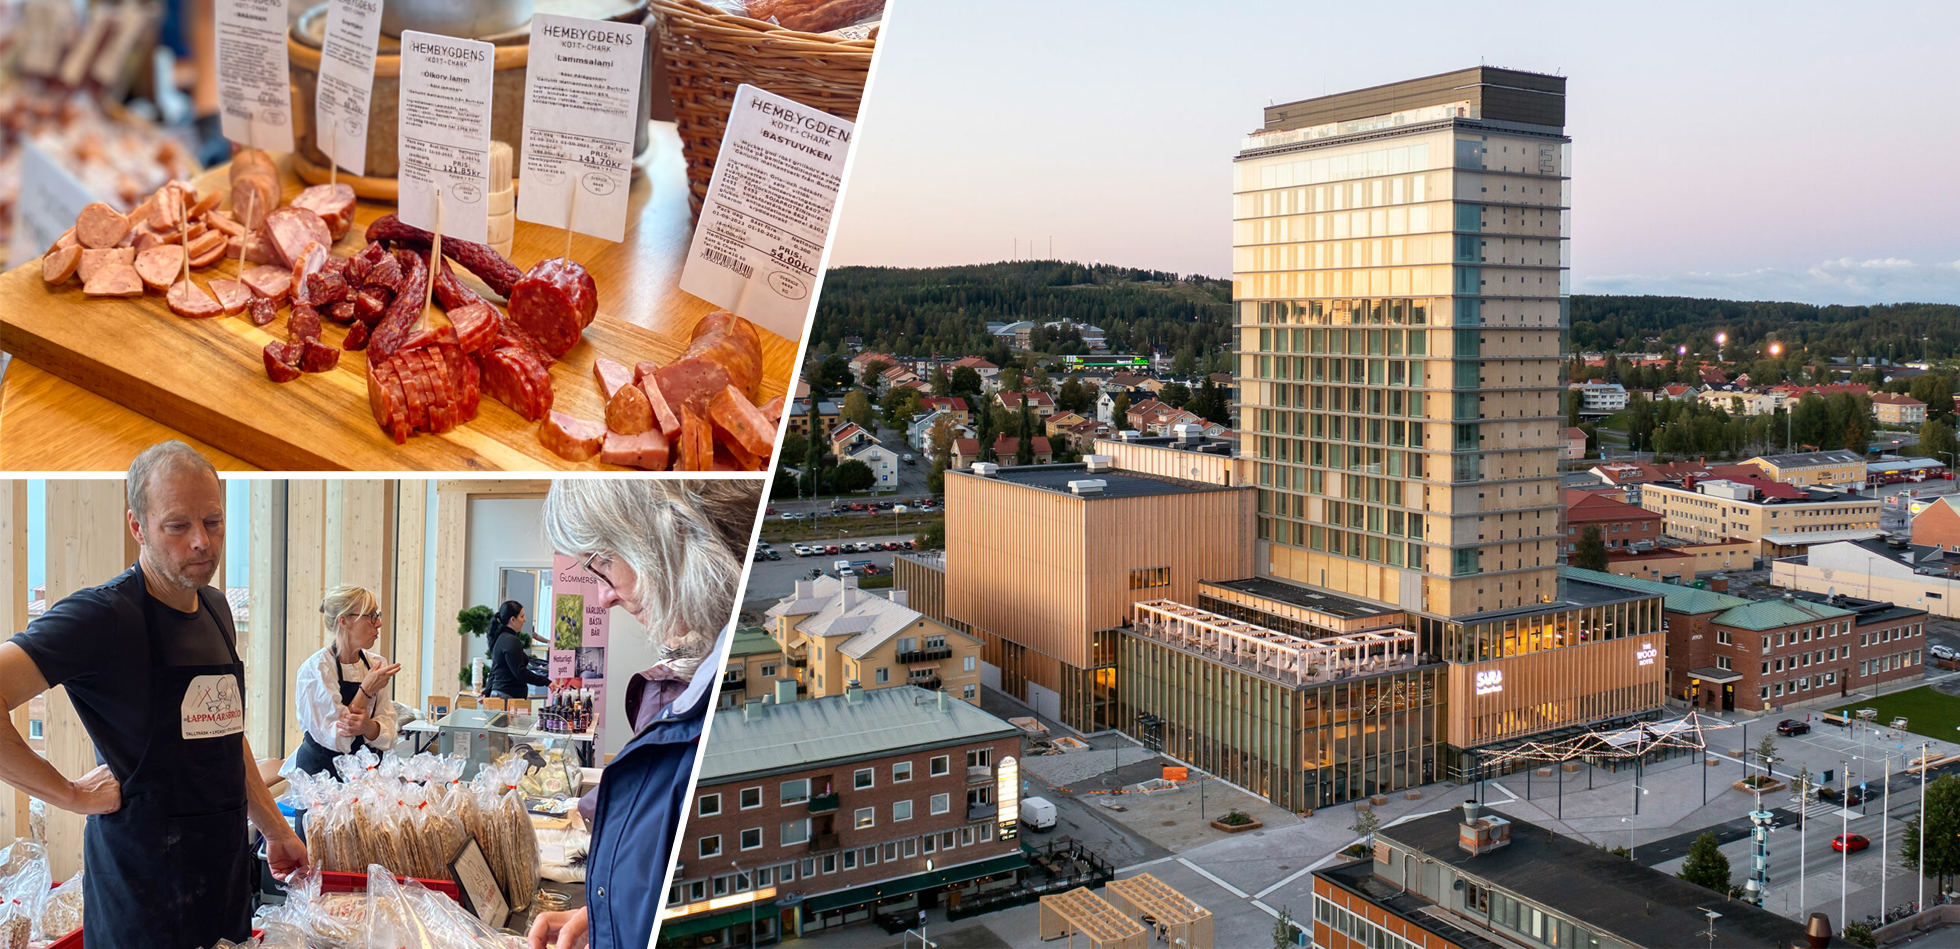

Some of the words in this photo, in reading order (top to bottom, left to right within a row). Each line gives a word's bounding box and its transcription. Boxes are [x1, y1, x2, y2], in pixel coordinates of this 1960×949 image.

[544, 26, 633, 45] HEMBYGDENS
[413, 42, 485, 61] HEMBYGDENS
[586, 44, 611, 52] CHARK
[448, 59, 467, 67] CHARK
[557, 55, 613, 67] Lammsalami
[449, 75, 470, 83] lamm
[751, 99, 851, 142] HEMBYGDEN
[763, 130, 832, 161] BASTUVIKEN
[801, 131, 831, 147] CHARK
[578, 155, 622, 168] 141.70kr
[590, 150, 610, 159] PRIS:
[742, 140, 764, 151] Mycket
[792, 160, 820, 173] grillkorv
[443, 164, 480, 178] 121.85kr
[453, 160, 470, 168] PRIS:
[735, 149, 759, 161] Genuint
[801, 175, 814, 183] från
[717, 205, 730, 213] Pack
[712, 210, 745, 226] 01-09-2023
[747, 224, 780, 241] 01-10-2023
[791, 236, 821, 252] Nettovikt
[779, 245, 802, 260] PRIS:
[769, 248, 814, 274] 54.00kr
[585, 604, 607, 615] VÄRLDENS
[589, 616, 602, 625] BÄSTA
[591, 627, 600, 636] BÄR
[1636, 649, 1657, 659] WOOD
